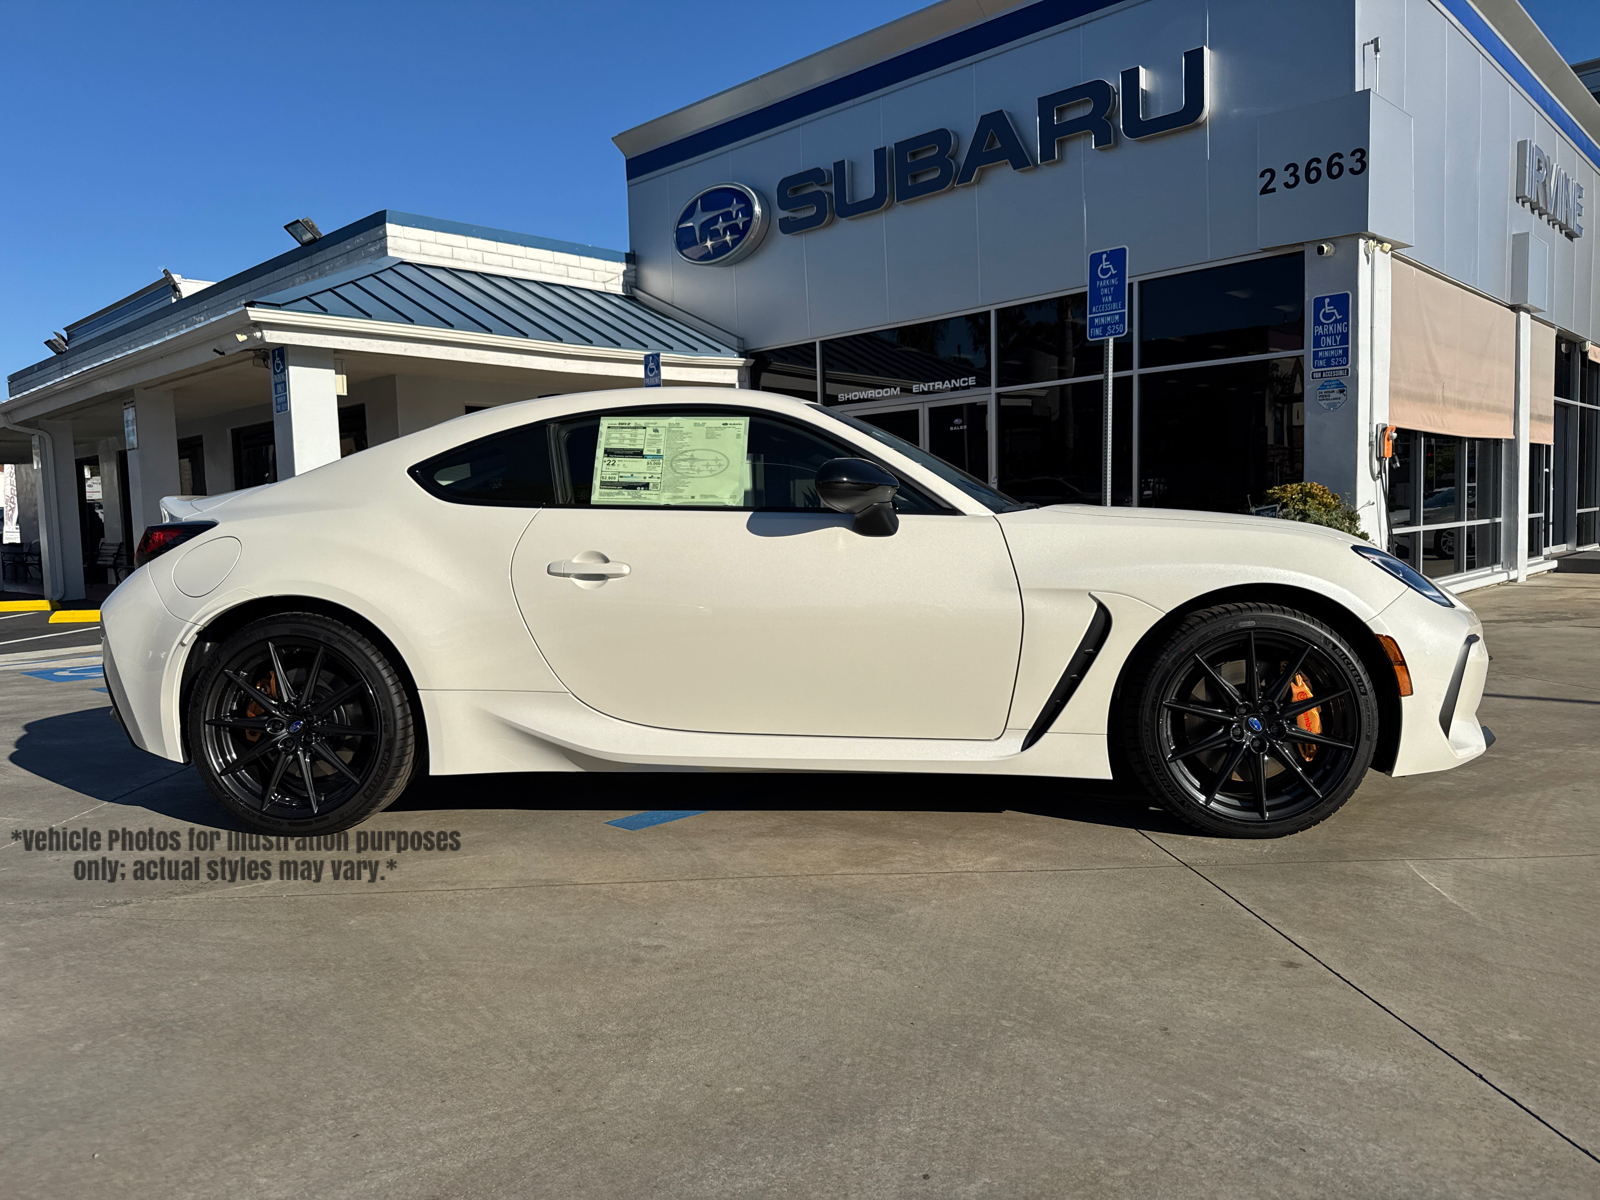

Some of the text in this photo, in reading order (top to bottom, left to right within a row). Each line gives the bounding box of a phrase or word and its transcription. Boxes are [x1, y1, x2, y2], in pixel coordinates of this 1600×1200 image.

[776, 46, 1210, 235] SUBARU
[1259, 147, 1367, 196] 23663
[1516, 138, 1584, 239] IRVINE
[1096, 277, 1119, 288] PARKING
[1100, 286, 1114, 296] ONLY
[1102, 295, 1112, 303] VAN
[1092, 301, 1122, 313] ACCESSIBLE
[1094, 314, 1120, 326] MINIMUM
[1090, 324, 1123, 337] FINE $250
[1314, 322, 1348, 336] PARKING
[1320, 335, 1341, 347] ONLY
[1318, 349, 1343, 358] MINIMUM
[1314, 356, 1347, 367] FINE $250
[1322, 369, 1347, 377] ACCESSIBLE
[838, 376, 976, 402] SHOWROOM ENTRANCE
[1334, 648, 1367, 694] MICHELIN
[364, 751, 390, 796] MICHELIN
[1150, 757, 1183, 802] MICHELIN
